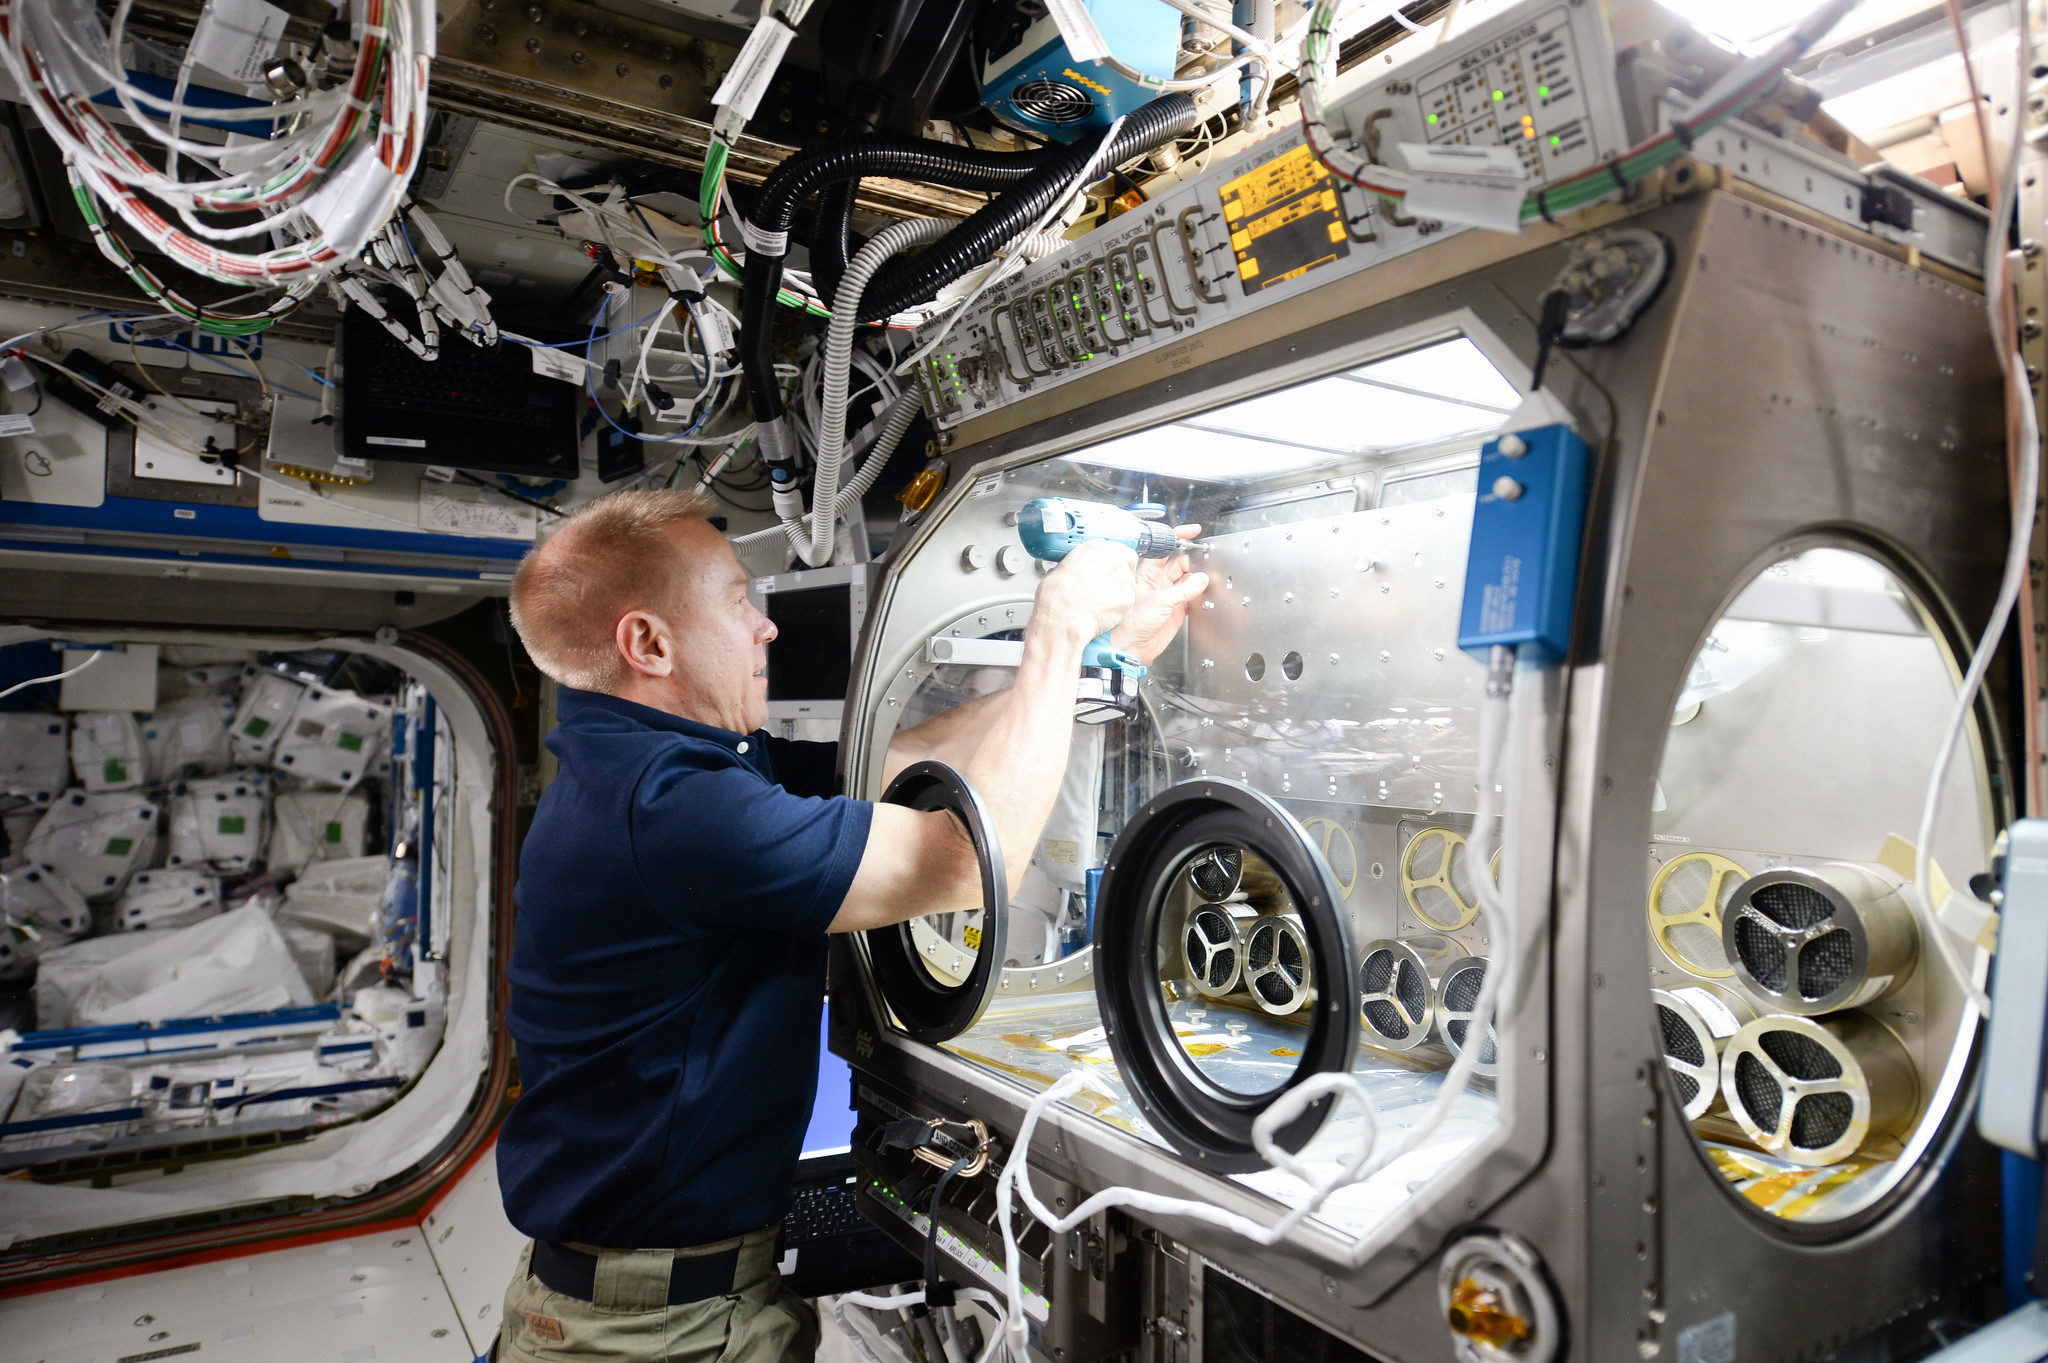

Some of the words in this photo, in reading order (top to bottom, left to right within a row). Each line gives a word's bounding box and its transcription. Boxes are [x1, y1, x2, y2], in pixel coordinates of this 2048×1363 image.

[1251, 150, 1276, 170] CONTROL
[1277, 136, 1299, 156] CENTRE
[1104, 239, 1121, 251] SPECIAL
[1121, 225, 1144, 241] FUNCTIONS
[1072, 252, 1093, 266] FUNCTIONS
[1011, 281, 1030, 299] EXPERIMENT
[1031, 276, 1044, 287] POWER
[1044, 268, 1060, 282] OUTLETS
[916, 312, 941, 334] COMMAND
[987, 284, 1008, 298] PANEL
[1008, 270, 1025, 287] (CMP)
[877, 1096, 898, 1118] POWER
[935, 1131, 949, 1147] AND
[948, 1244, 964, 1258] AIRLOCK
